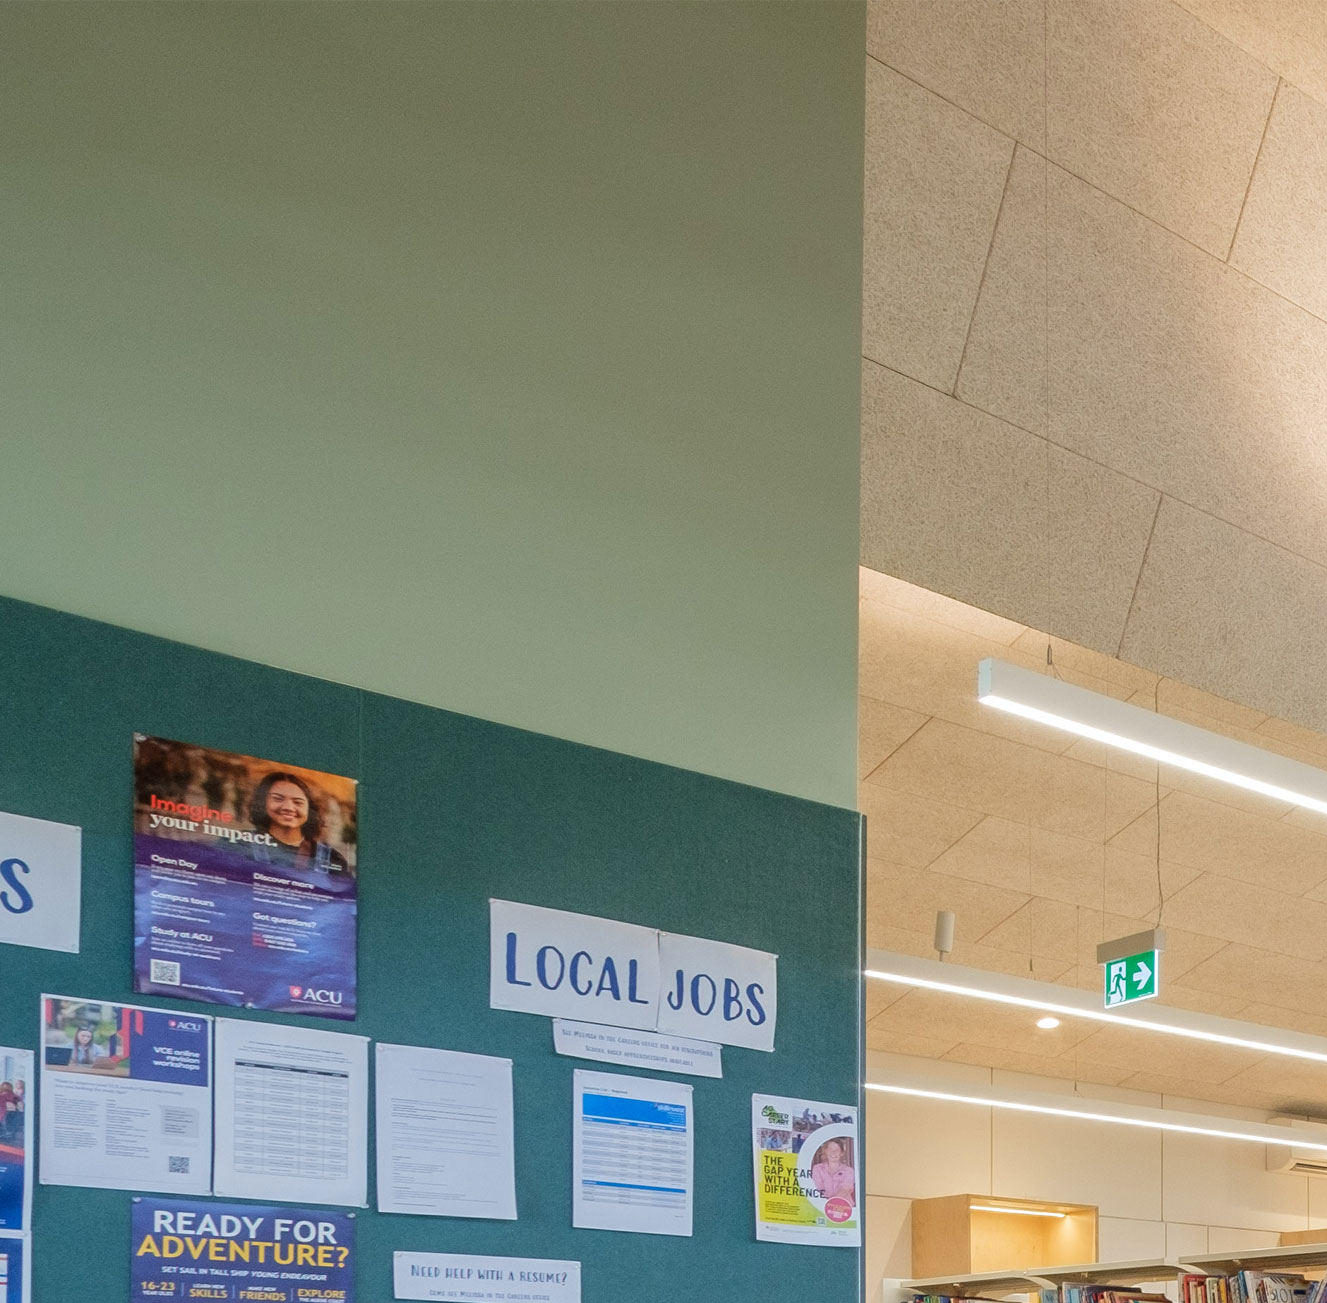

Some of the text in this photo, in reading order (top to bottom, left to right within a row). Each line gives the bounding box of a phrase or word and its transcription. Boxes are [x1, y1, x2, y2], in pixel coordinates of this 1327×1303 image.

[150, 794, 235, 822] Imagine
[150, 813, 278, 847] your impact.
[151, 854, 198, 870] Open Day
[506, 932, 766, 1026] LOCAL JOBS
[304, 988, 342, 1004] ACU
[177, 1020, 201, 1031] ACU
[764, 1155, 784, 1167] THE
[764, 1165, 813, 1179] GAP YEAR
[764, 1175, 800, 1187] WITH A
[764, 1184, 827, 1199] DIFFERENCE
[154, 1210, 337, 1244] READY FOR
[136, 1234, 349, 1268] ADVENTURE?
[209, 1268, 230, 1276] TALL
[231, 1269, 250, 1277] SHIP
[251, 1270, 279, 1279] YOUNG
[411, 1264, 440, 1278] NEED
[445, 1267, 474, 1280] HELP
[477, 1269, 502, 1281] WITH
[508, 1271, 514, 1282] A
[141, 1281, 175, 1292] 16-23
[189, 1288, 228, 1299] SKILLS
[297, 1288, 346, 1299] EXPLORE
[239, 1290, 287, 1302] FRIENDS
